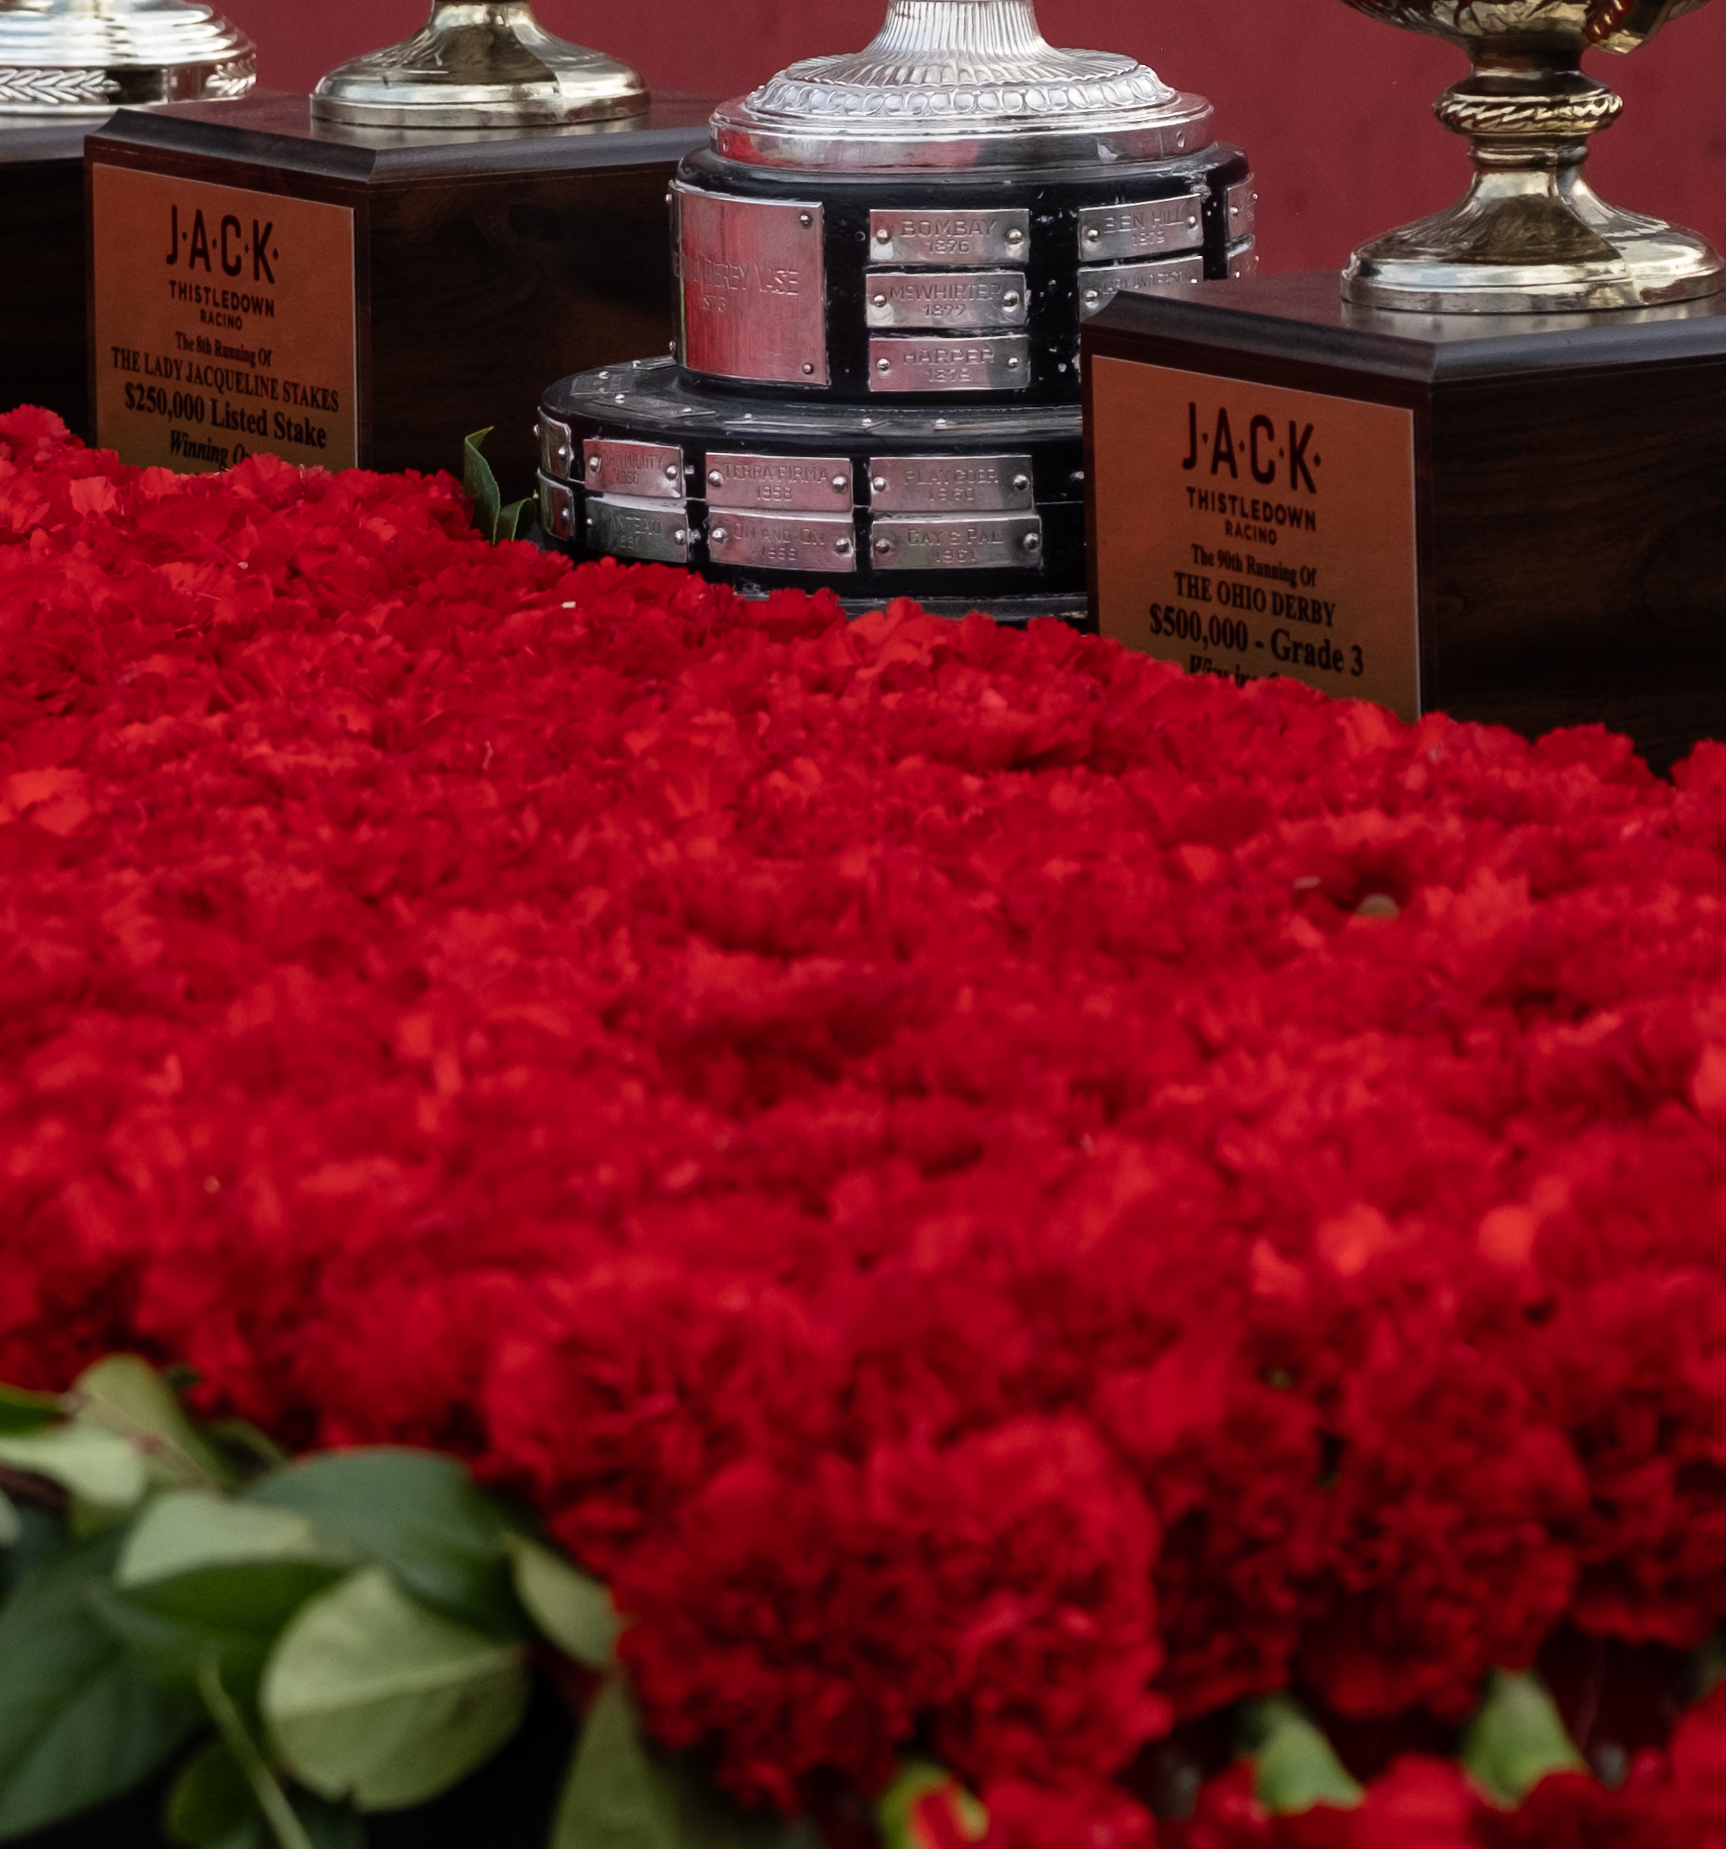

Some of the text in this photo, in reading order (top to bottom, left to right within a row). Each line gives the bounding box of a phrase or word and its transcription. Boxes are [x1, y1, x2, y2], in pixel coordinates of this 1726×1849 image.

[901, 219, 997, 238] BOMBAY
[1104, 205, 1185, 234] BEN HILL
[166, 204, 275, 284] JACK
[926, 239, 970, 255] 1876
[169, 280, 275, 318] THISTLEDOWN
[923, 303, 966, 317] 1877
[200, 310, 243, 331] RACINO
[176, 331, 272, 368] The 8th Running Of
[903, 347, 994, 366] HARPER
[112, 346, 339, 412] THE LADY JACQUELINE STAKES
[925, 367, 972, 383] 1878
[125, 382, 327, 450] $250,000 Listed Stake
[170, 430, 228, 470] Winning
[1182, 401, 1317, 494] JACK
[724, 464, 829, 484] TERRA FIRMA
[755, 485, 793, 502] 1958
[1186, 486, 1317, 532] THISTLEDOWN
[966, 527, 1005, 545] PAL
[1225, 519, 1278, 546] RACINO
[1191, 543, 1317, 589] The 90th Running Of
[1175, 572, 1336, 628] THE OHIO DERBY
[1150, 604, 1248, 652] $500,000
[1270, 628, 1344, 674] Grade
[1351, 643, 1365, 678] 3
